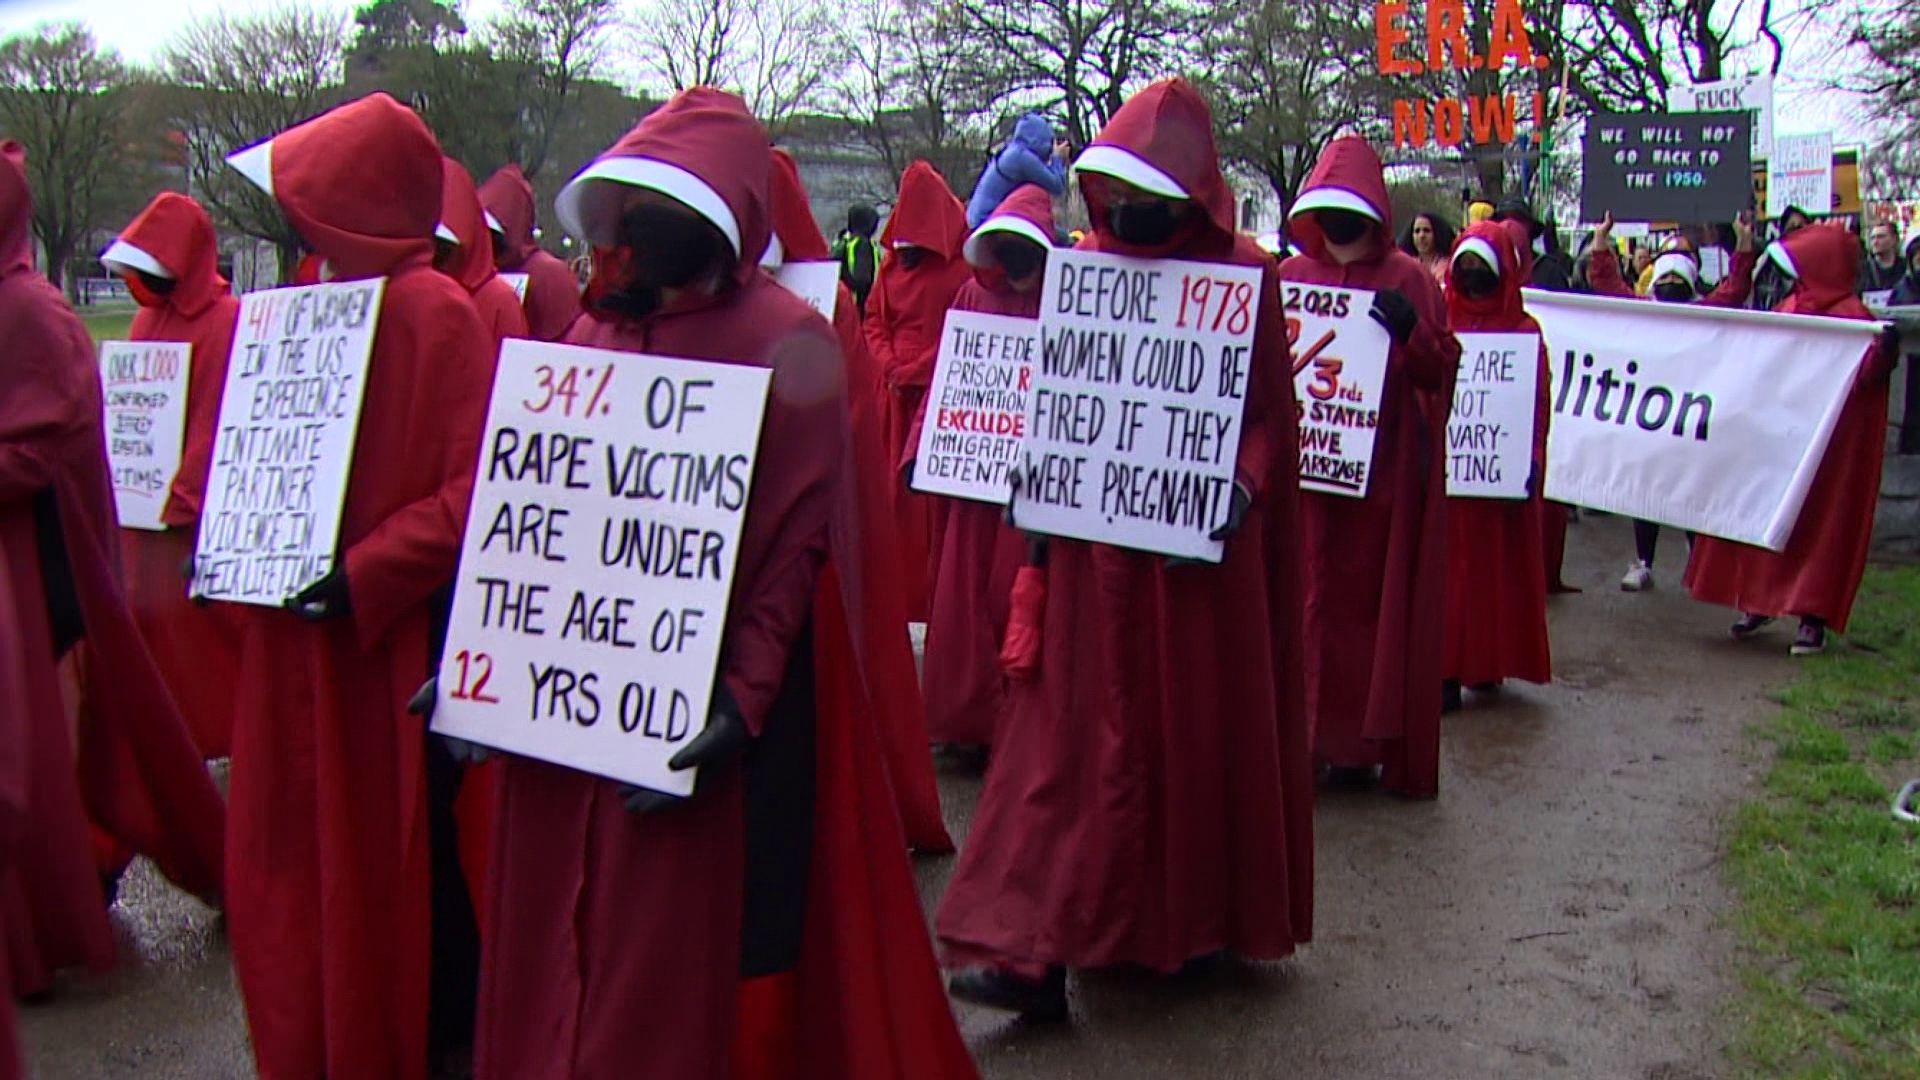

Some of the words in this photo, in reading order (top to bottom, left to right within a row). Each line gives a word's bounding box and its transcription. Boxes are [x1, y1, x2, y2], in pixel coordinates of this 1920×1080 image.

[1376, 0, 1549, 75] E.R.A.
[1394, 91, 1543, 148] NOW!
[1601, 127, 1624, 143] WE
[1641, 127, 1683, 143] WILL
[1702, 126, 1735, 143] NOT
[1614, 149, 1638, 165] GO
[1653, 149, 1691, 166] BACK
[1699, 150, 1719, 166] TO
[1626, 173, 1656, 188] THE
[285, 291, 312, 337] OF
[1057, 262, 1161, 324] BEFORE
[1175, 274, 1254, 335] 1978
[1284, 287, 1350, 318] 2025
[240, 343, 270, 379] IN
[276, 338, 310, 376] THE
[316, 336, 348, 375] US
[953, 328, 985, 359] THE
[1041, 325, 1126, 383] WOMEN
[1132, 336, 1206, 395] COULD
[1217, 346, 1249, 399] BE
[1472, 350, 1516, 382] ARE
[250, 374, 352, 421] EXPERIENCE
[947, 361, 1013, 388] PRISON
[1555, 350, 1713, 441] lition
[523, 363, 614, 419] 34%
[645, 376, 714, 434] OF
[941, 386, 1027, 412] ELIMINATION
[1309, 401, 1377, 428] STATES
[217, 422, 325, 466] INTIMATE
[936, 408, 1025, 438] EXCLUDE
[1033, 389, 1106, 446] FIRED
[1115, 400, 1147, 452] IF
[1163, 405, 1231, 465] THEY
[222, 464, 315, 511] PARTNER
[488, 427, 593, 489] RAPE
[607, 442, 748, 513] VICTIMS
[1026, 452, 1087, 509] WERE
[1101, 460, 1229, 531] PREGNANT
[1445, 454, 1502, 483] TING
[204, 511, 283, 552] VIOLENCE
[282, 511, 317, 550] IN
[481, 503, 570, 562] ARE
[601, 517, 725, 581] UNDER
[476, 577, 549, 636] THE
[561, 591, 636, 649] AGE
[651, 608, 705, 653] OF
[449, 649, 499, 704] 12
[529, 661, 600, 727] YRS
[618, 681, 691, 743] OLD
